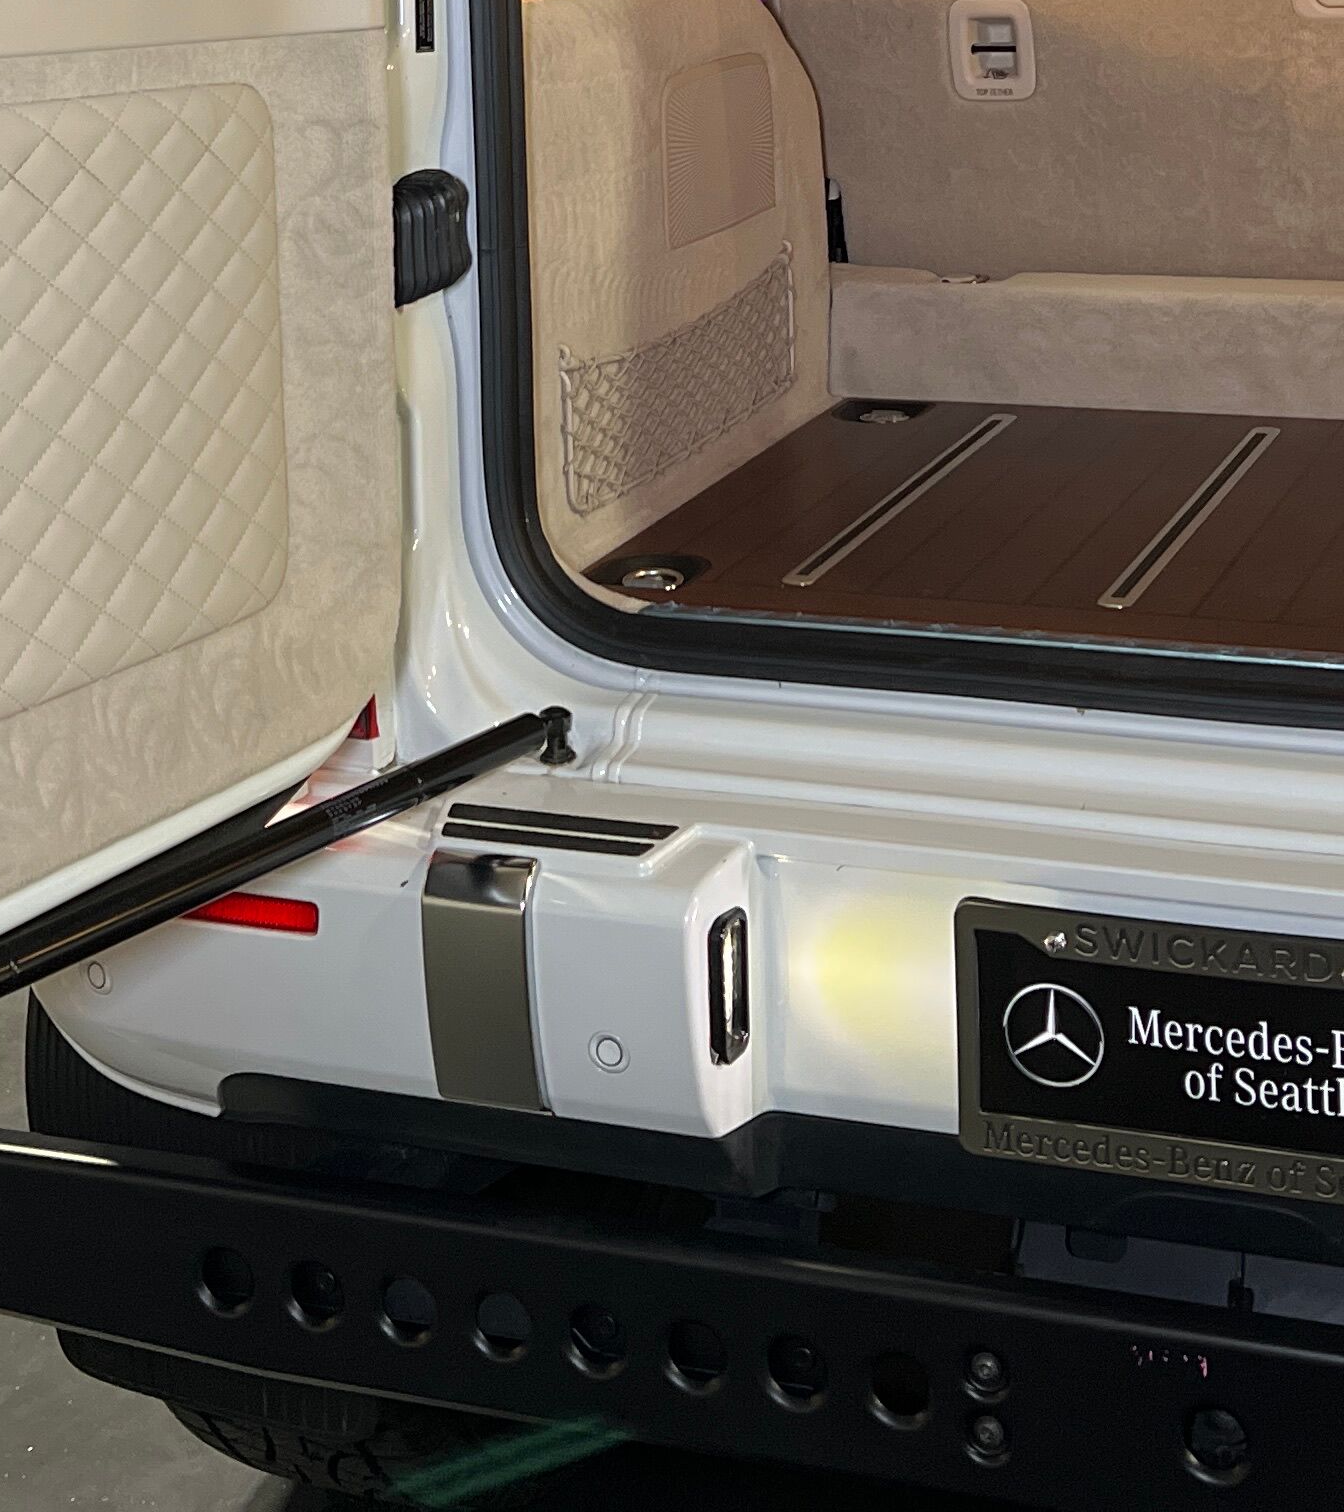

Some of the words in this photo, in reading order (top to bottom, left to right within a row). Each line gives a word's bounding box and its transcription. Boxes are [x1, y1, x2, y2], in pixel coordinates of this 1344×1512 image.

[1074, 923, 1335, 984] SWICKARD
[1184, 1065, 1222, 1103] of
[982, 1120, 1256, 1187] Mercedes-Benz
[1266, 1159, 1306, 1195] of
